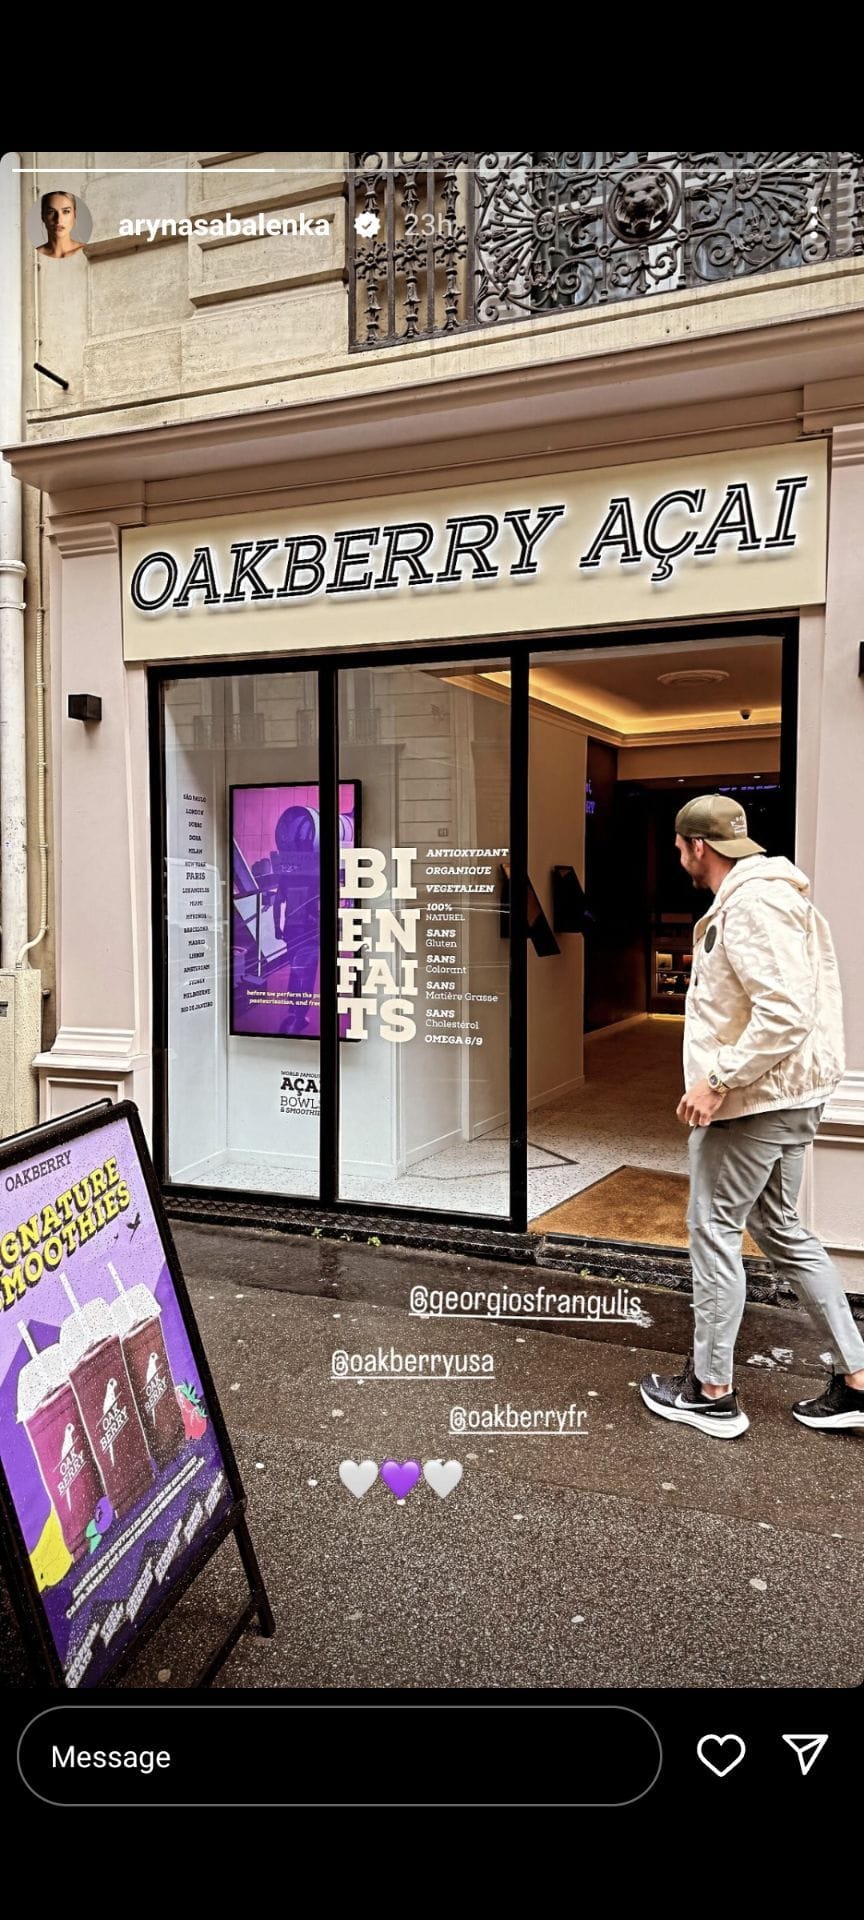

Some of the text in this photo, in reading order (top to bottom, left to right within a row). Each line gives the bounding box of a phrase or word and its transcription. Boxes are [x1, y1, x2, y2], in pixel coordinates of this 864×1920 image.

[131, 476, 808, 611] OAKBERRY AÇAI
[426, 848, 509, 858] ANTIOXYDANT
[186, 871, 206, 881] PARIS
[339, 847, 417, 899] BI
[425, 866, 493, 875] ORGANIQUE
[426, 884, 496, 893] VEGETALIEN
[426, 903, 453, 912] 100%
[425, 913, 466, 921] NATUREL
[338, 909, 420, 953] EN
[426, 928, 456, 938] SANS
[425, 938, 458, 948] Gluten
[426, 954, 456, 963] SANS
[337, 958, 418, 995] FAI
[425, 964, 467, 975] Colorant
[426, 981, 456, 990] SANS
[425, 991, 498, 1002] Matière Grasse
[337, 997, 417, 1042] TS
[425, 1009, 456, 1018] SANS
[425, 1019, 479, 1030] Cholestérol
[425, 1034, 483, 1046] OMEGA 6/9
[280, 1077, 320, 1097] AÇA
[280, 1095, 320, 1109] BOWL
[5, 1150, 71, 1192] OAKBERRY
[0, 1156, 120, 1270] GNATURE
[0, 1180, 131, 1312] MOOTHIES
[145, 1372, 163, 1397] OAK
[144, 1375, 168, 1414] BERRY
[102, 1401, 121, 1430] OAK
[99, 1405, 129, 1449] BERRY
[59, 1446, 80, 1475] OAK
[57, 1449, 85, 1497] BERRY
